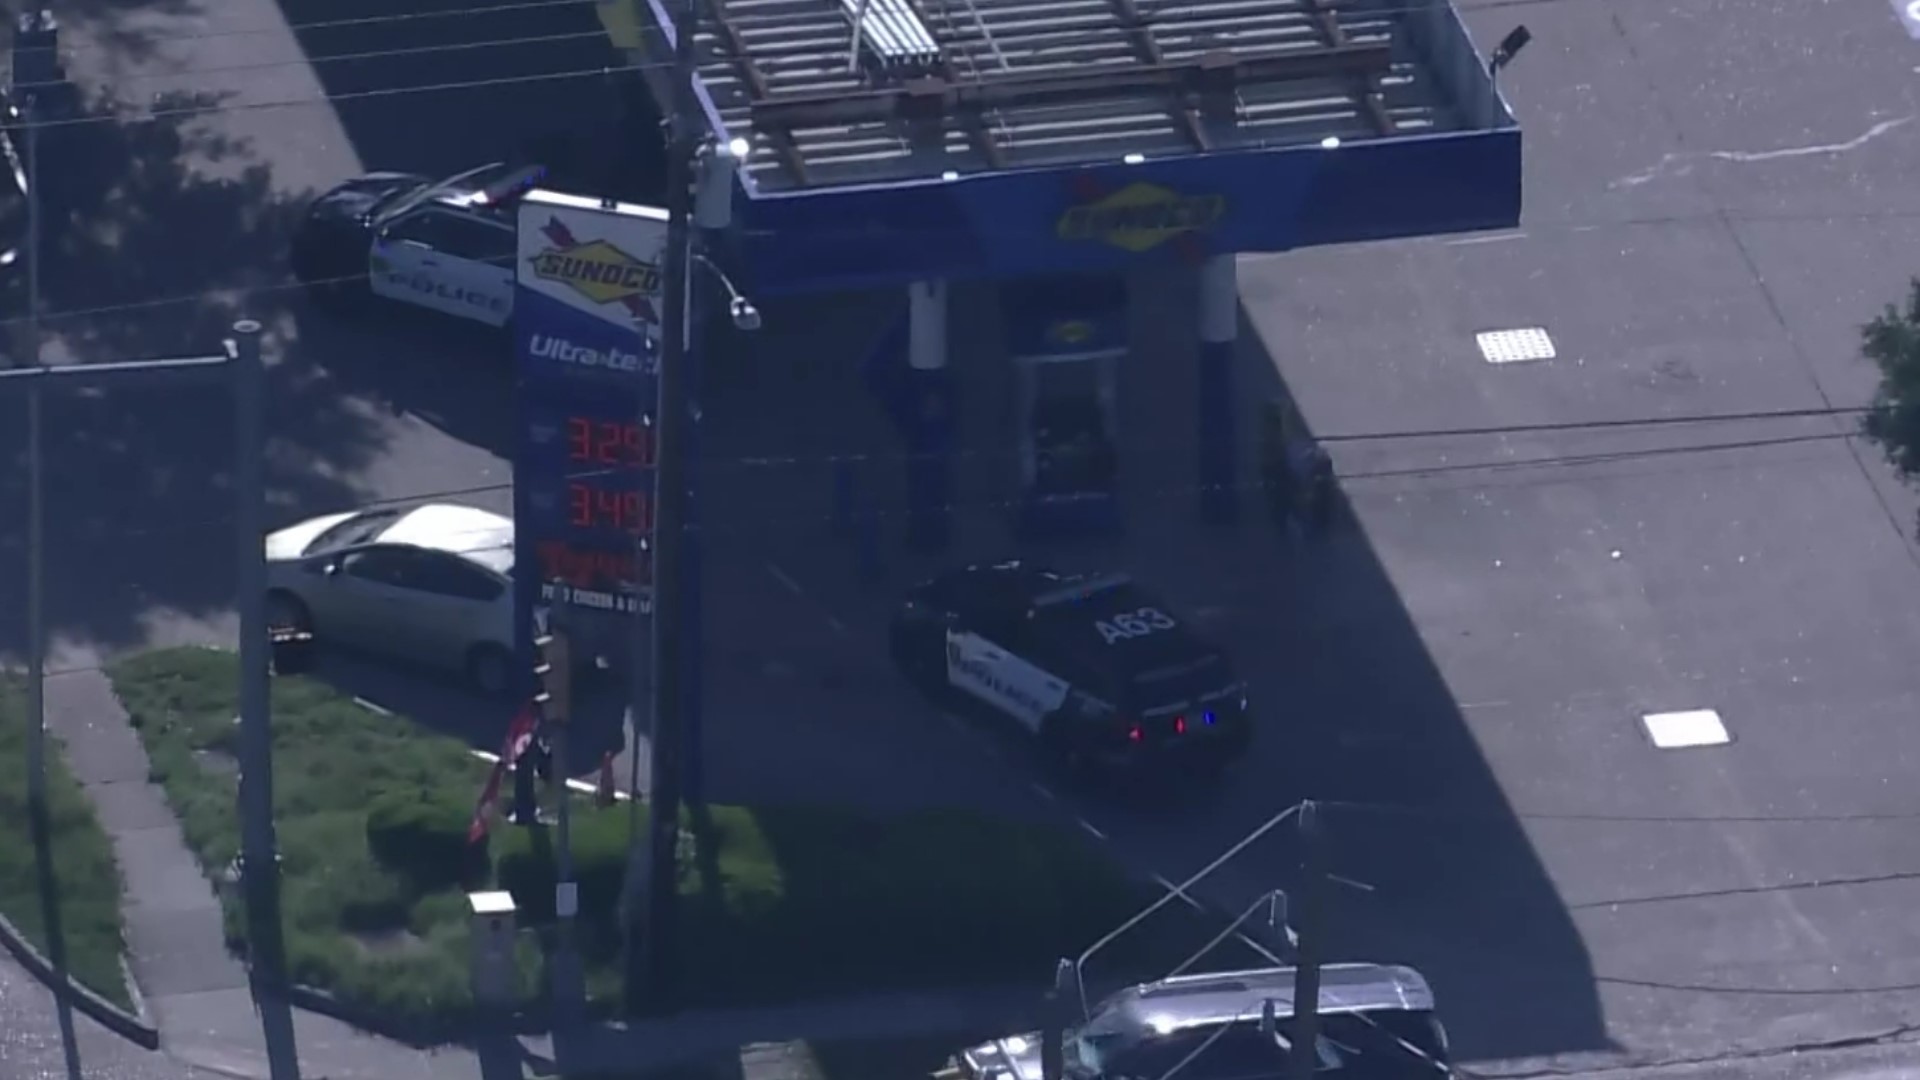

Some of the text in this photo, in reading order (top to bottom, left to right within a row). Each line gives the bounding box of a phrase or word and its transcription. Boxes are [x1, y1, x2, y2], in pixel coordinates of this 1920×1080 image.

[540, 253, 659, 292] SUNOCO
[388, 272, 507, 314] POLICE
[1094, 606, 1176, 645] A63
